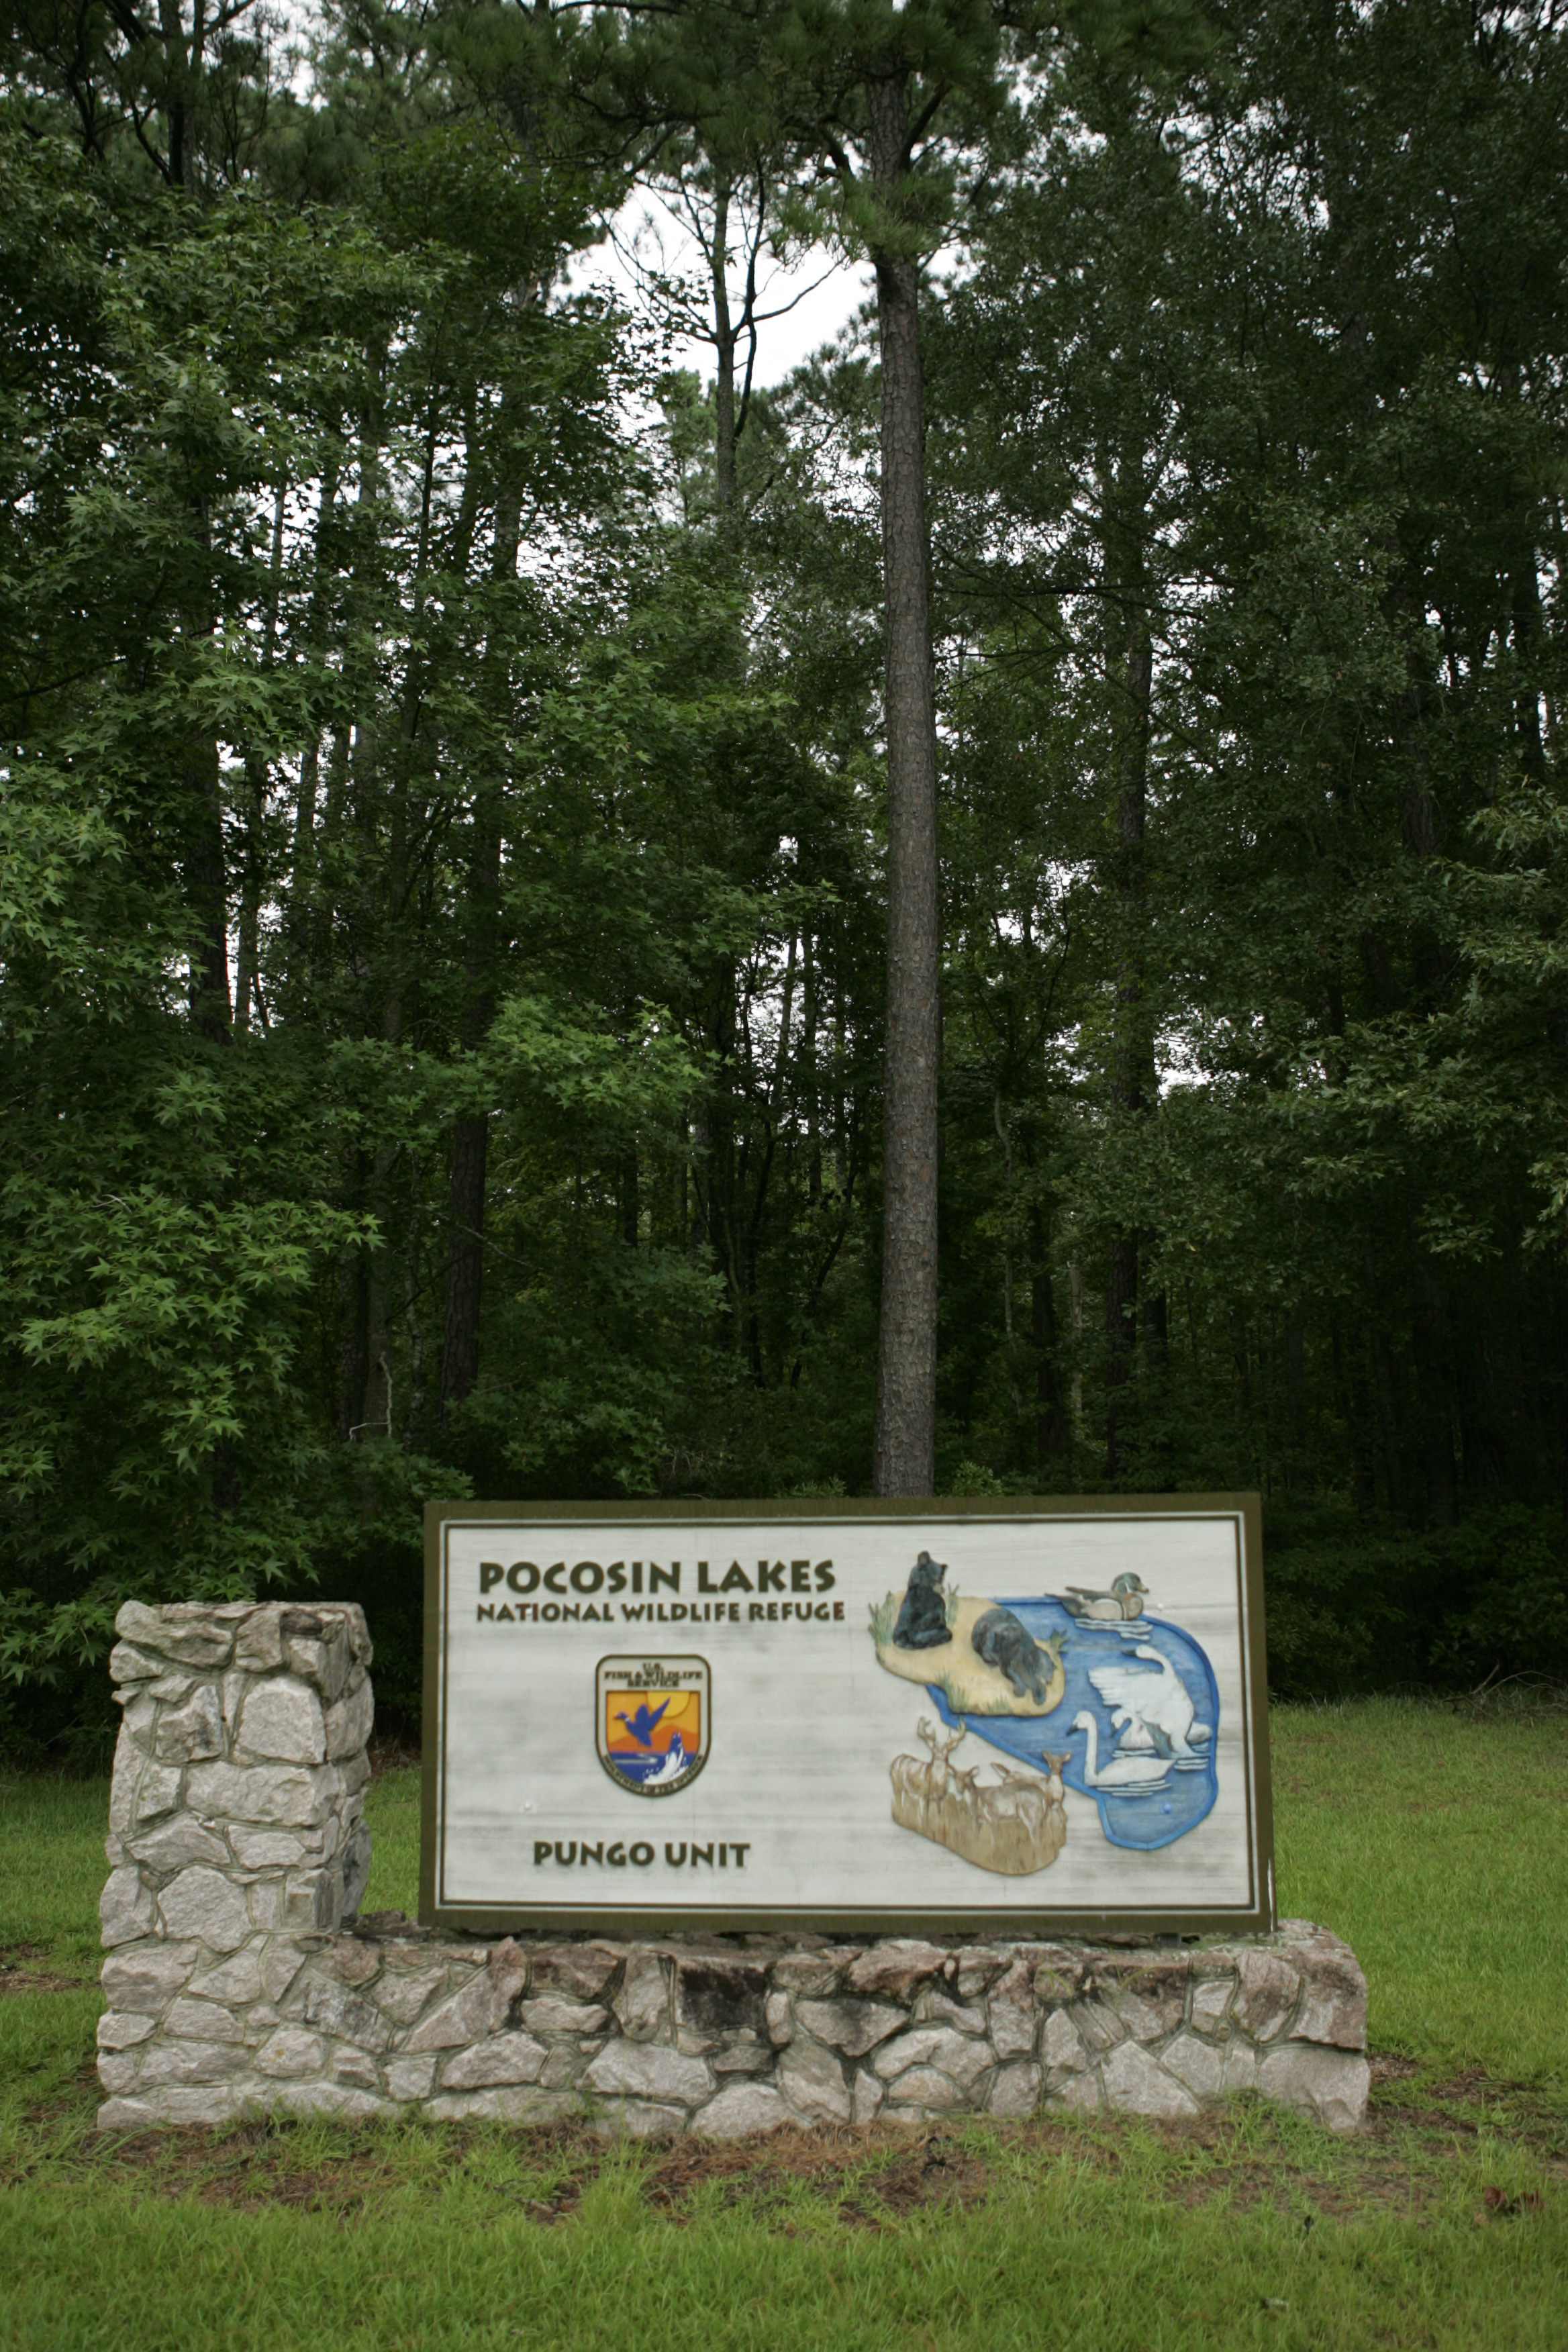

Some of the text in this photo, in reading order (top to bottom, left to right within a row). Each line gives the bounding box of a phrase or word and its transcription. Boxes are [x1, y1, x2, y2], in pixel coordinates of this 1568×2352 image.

[480, 1560, 835, 1595] POCOSIN LAKES
[477, 1602, 844, 1622] NATIONAL WILDLIFE REFUGE
[604, 1671, 633, 1679] FISH
[644, 1671, 703, 1679] WILDLIFE
[628, 1679, 680, 1688] SERVICE
[534, 1841, 750, 1868] PUNGO UNIT
